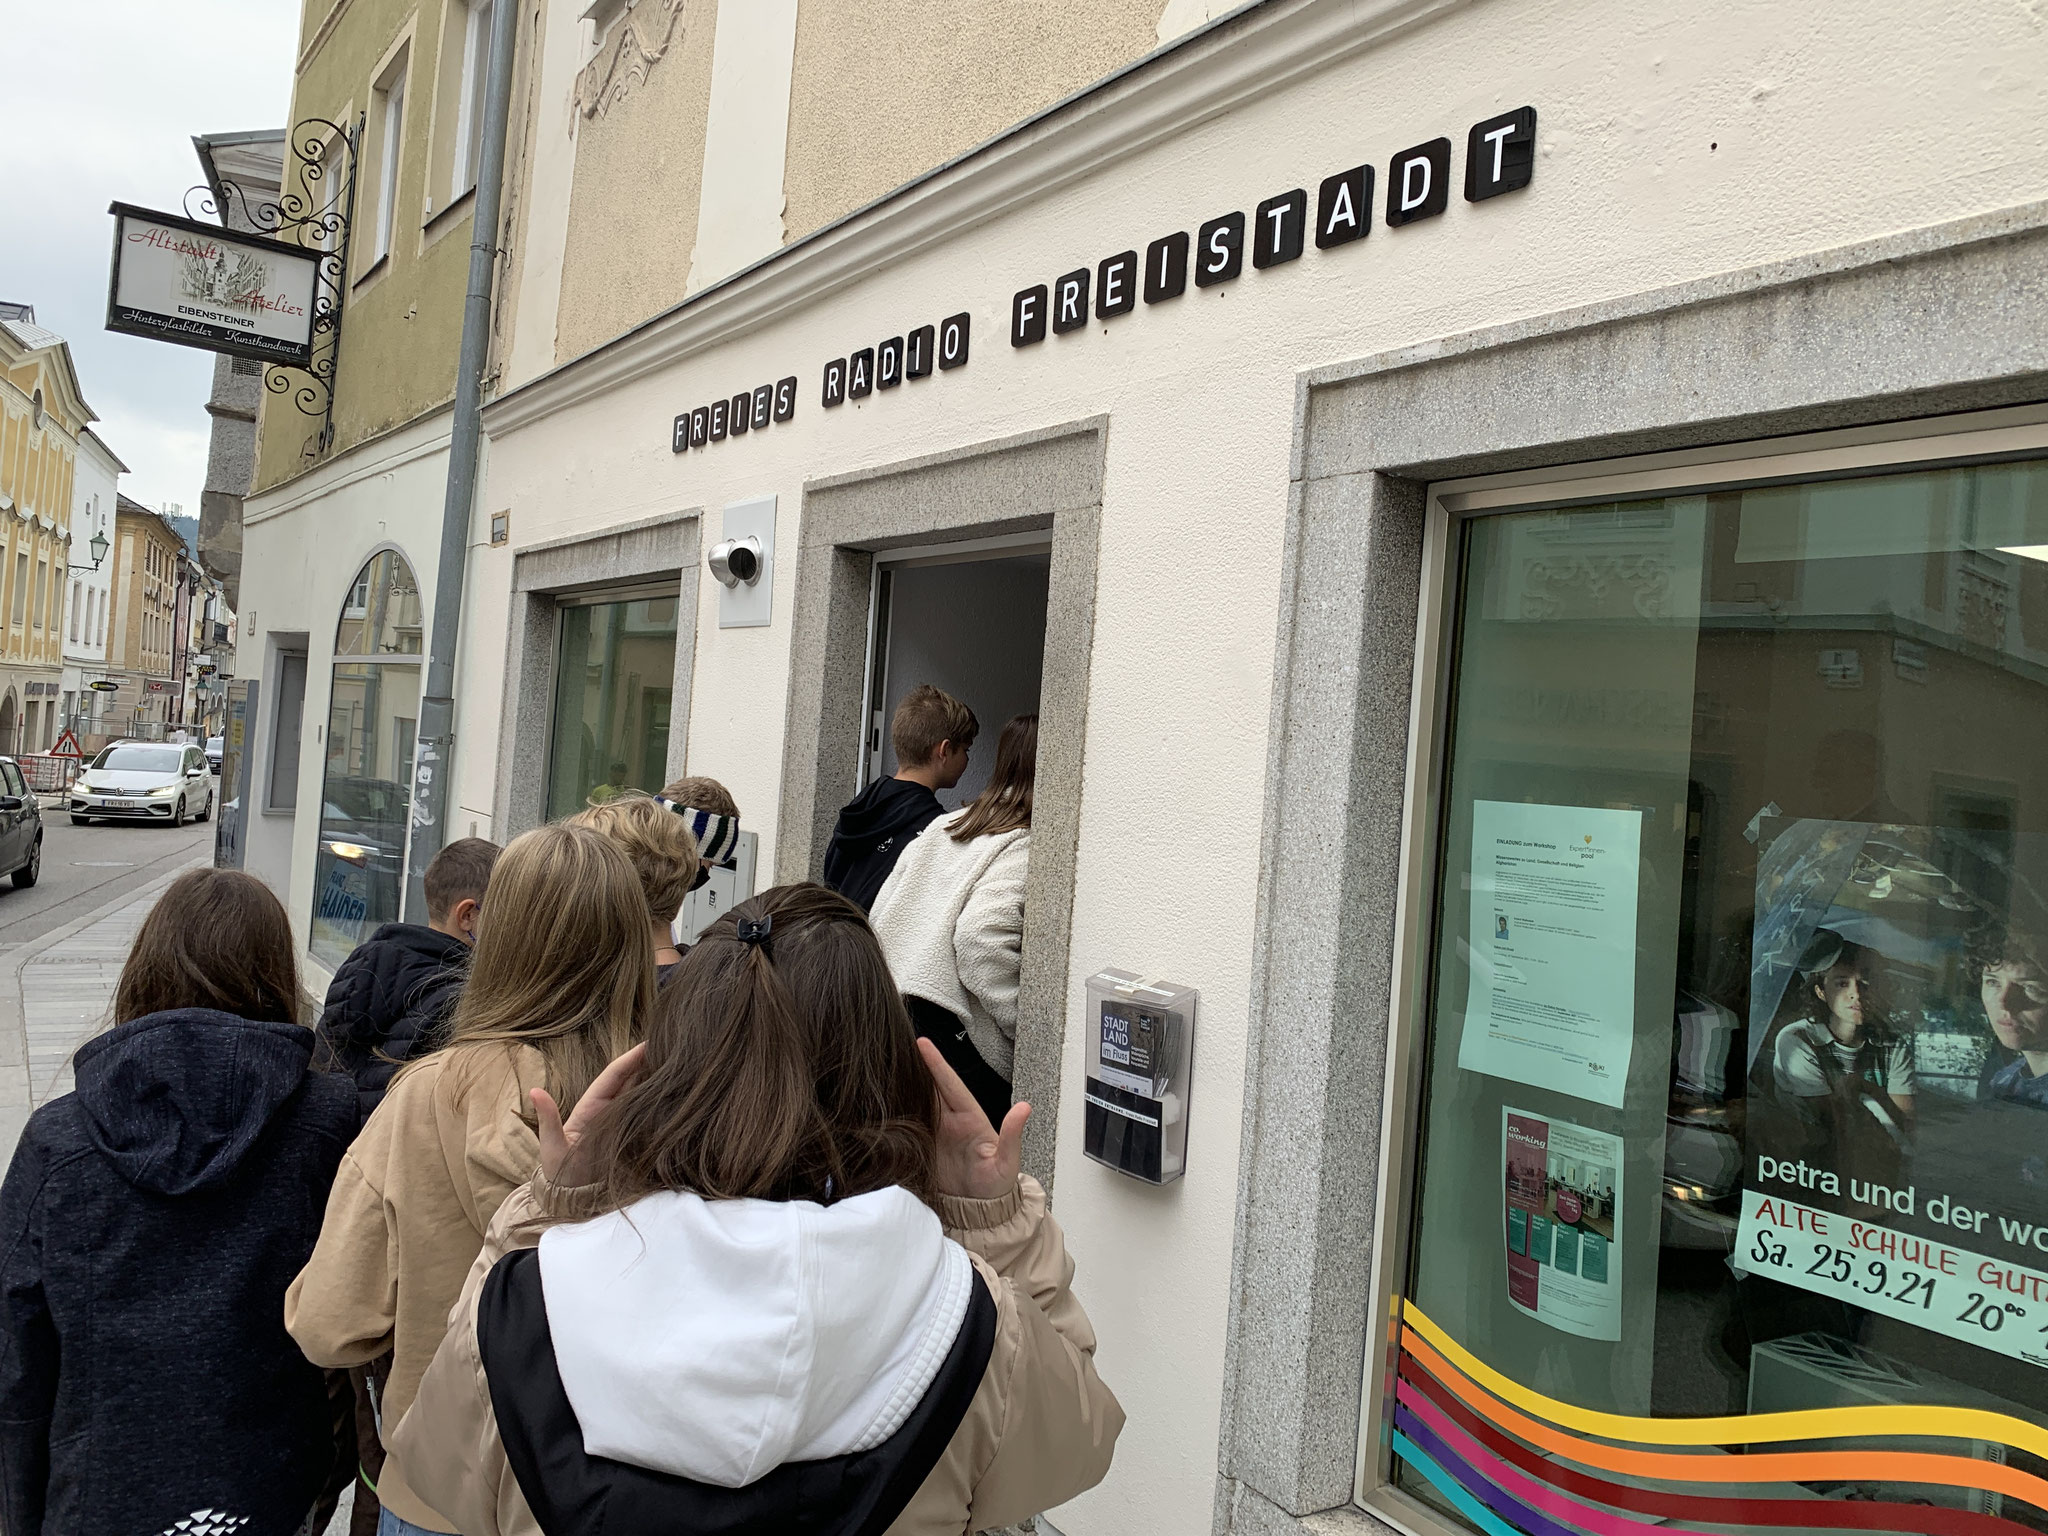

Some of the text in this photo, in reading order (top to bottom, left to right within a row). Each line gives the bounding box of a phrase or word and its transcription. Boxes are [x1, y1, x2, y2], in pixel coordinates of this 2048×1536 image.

[127, 228, 218, 260] Altstadt
[674, 122, 1517, 447] FREIES RADIO FREISTADT
[177, 304, 255, 328] EIBENSTEINER
[231, 287, 304, 317] Atelier
[122, 309, 302, 355] Hinterglasbilder Kunsthandwerk
[1103, 1015, 1129, 1033] STADT
[1103, 1028, 1129, 1046] LAND
[1102, 1045, 1112, 1059] im
[1112, 1049, 1128, 1062] Fluss
[1508, 1126, 1521, 1134] co.
[1508, 1132, 1546, 1149] working
[1757, 1154, 1841, 1197] petra
[1850, 1178, 1916, 1216] und
[1926, 1195, 1990, 1234] der
[1755, 1198, 2048, 1303] ALTE SCHULE GUT
[1750, 1229, 1794, 1269] Sa.
[1804, 1243, 1937, 1310] 25.9.21
